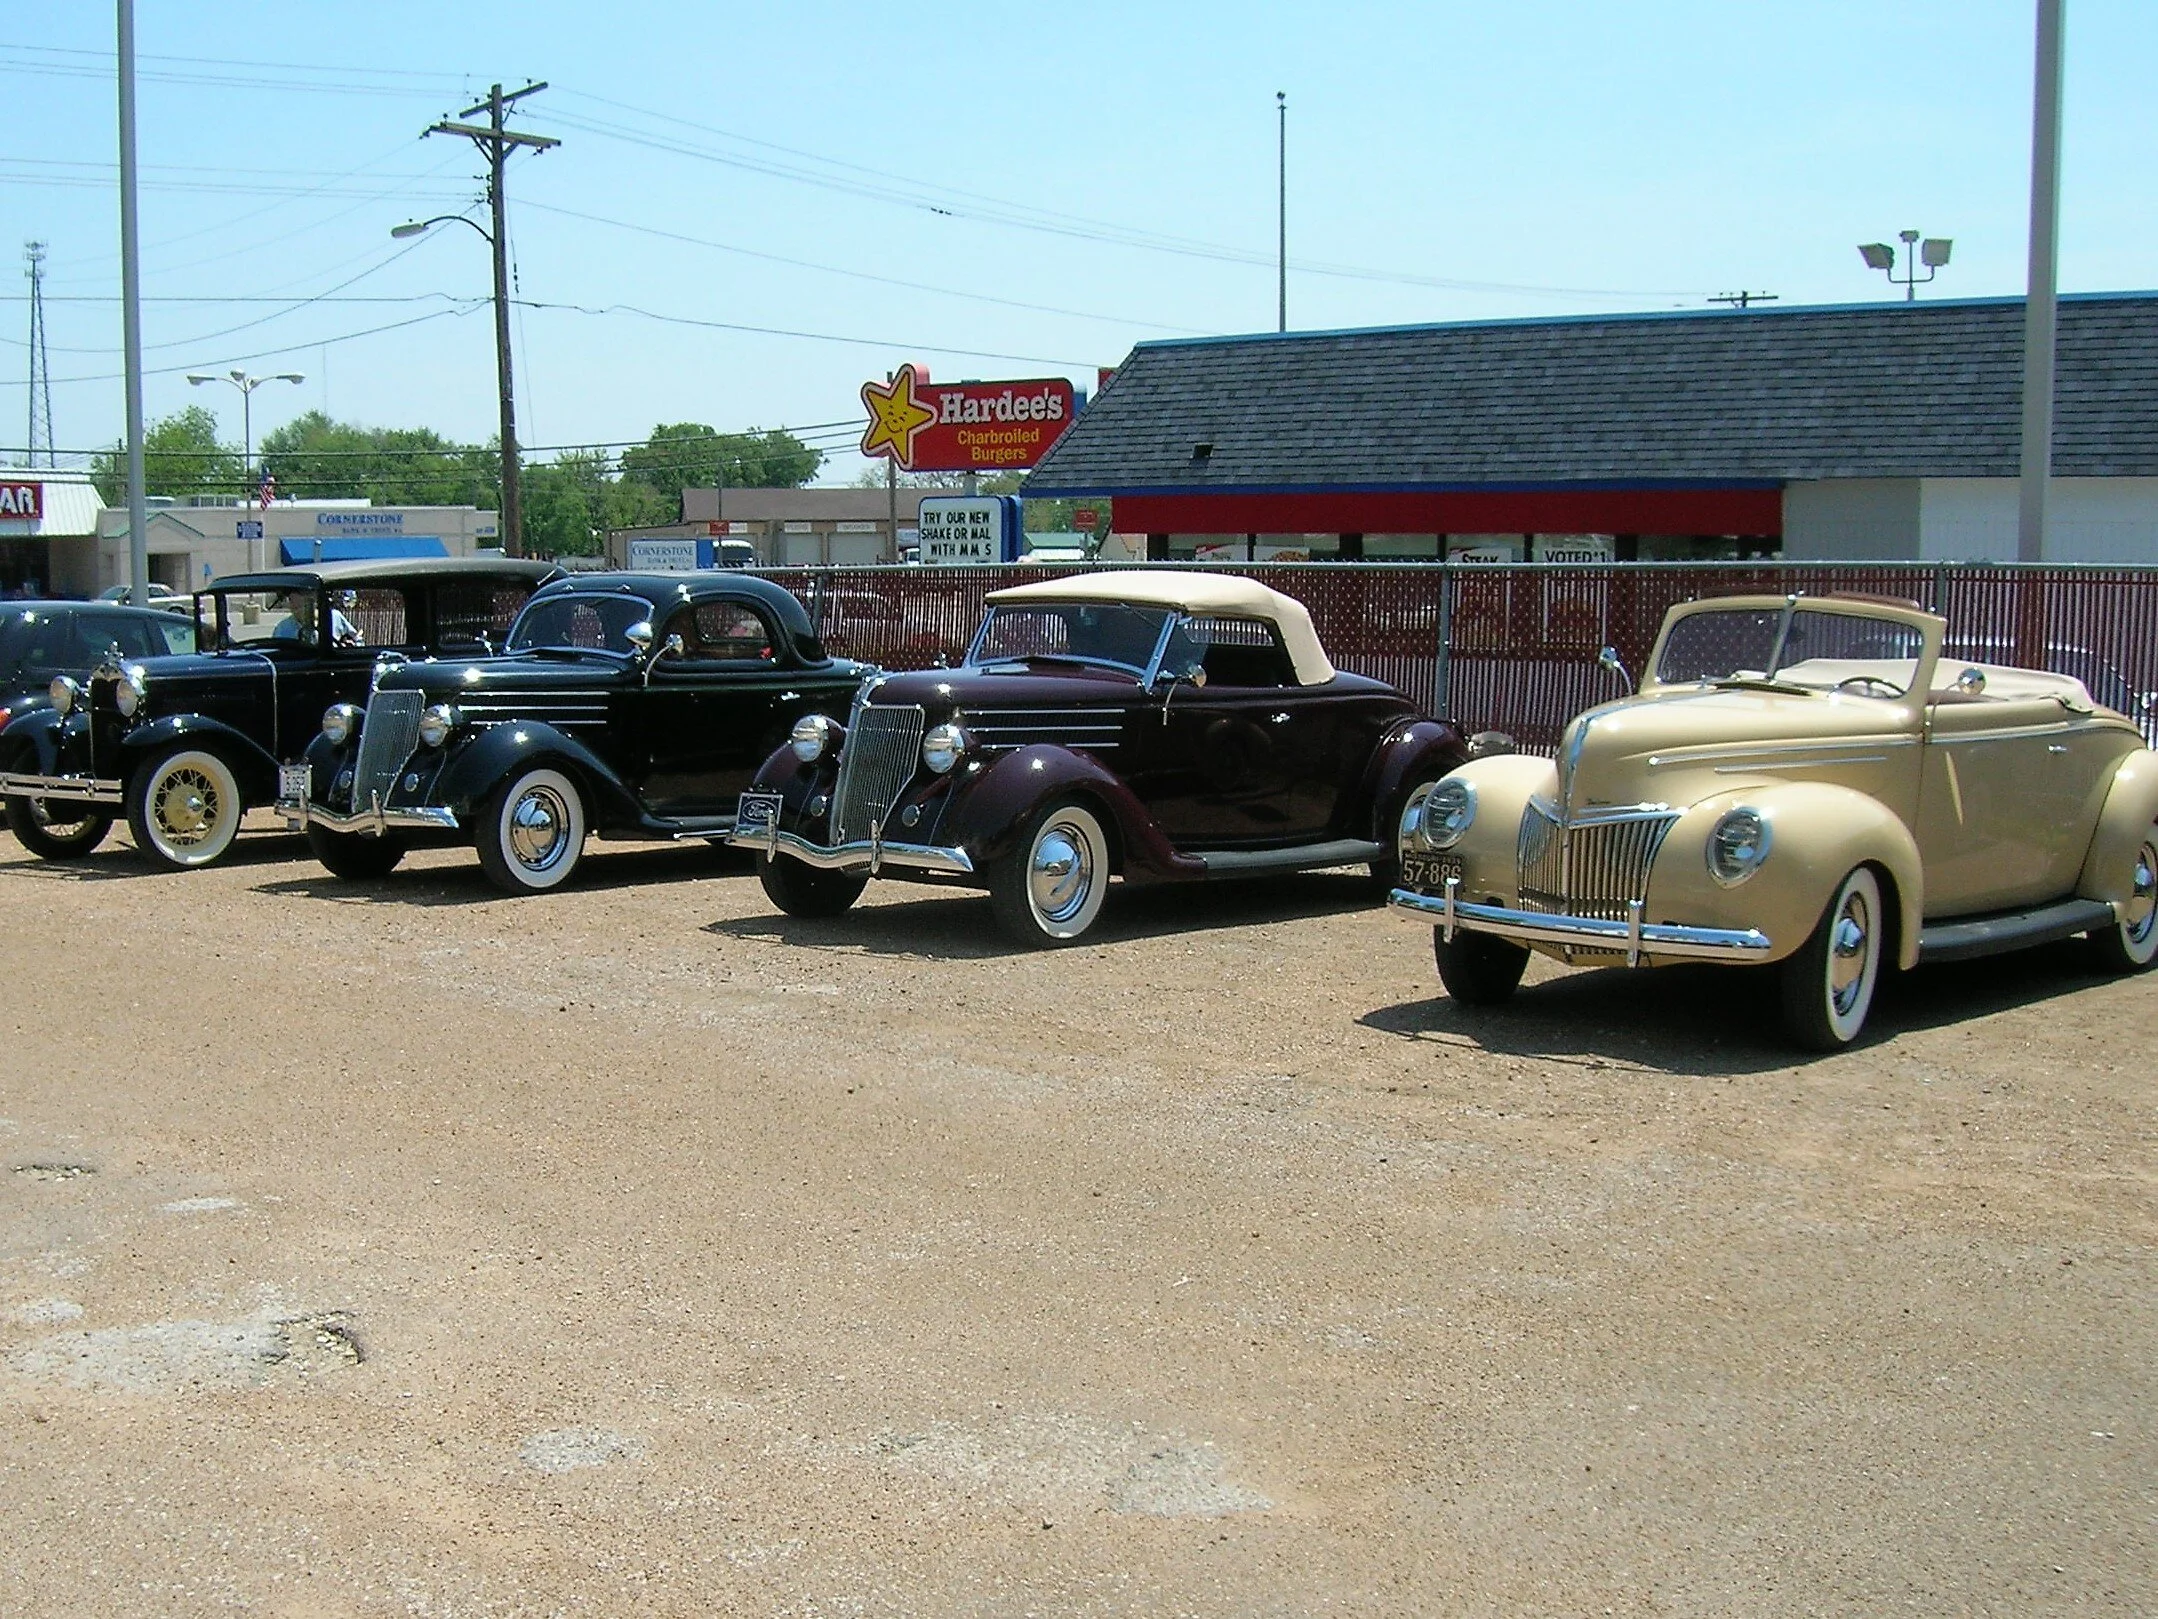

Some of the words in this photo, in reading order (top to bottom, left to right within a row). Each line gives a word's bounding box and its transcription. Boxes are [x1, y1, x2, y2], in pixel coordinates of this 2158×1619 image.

[940, 387, 1063, 423] Hardee's
[958, 428, 1039, 445] Charbroiled
[972, 446, 1027, 463] Burgers
[924, 512, 941, 524] TRY
[947, 512, 966, 524] OUR
[969, 511, 990, 524] NEW
[921, 527, 951, 540] SHAKE
[954, 527, 967, 540] OR
[971, 527, 991, 540] MAL
[931, 544, 955, 556] WITH
[985, 543, 992, 556] S
